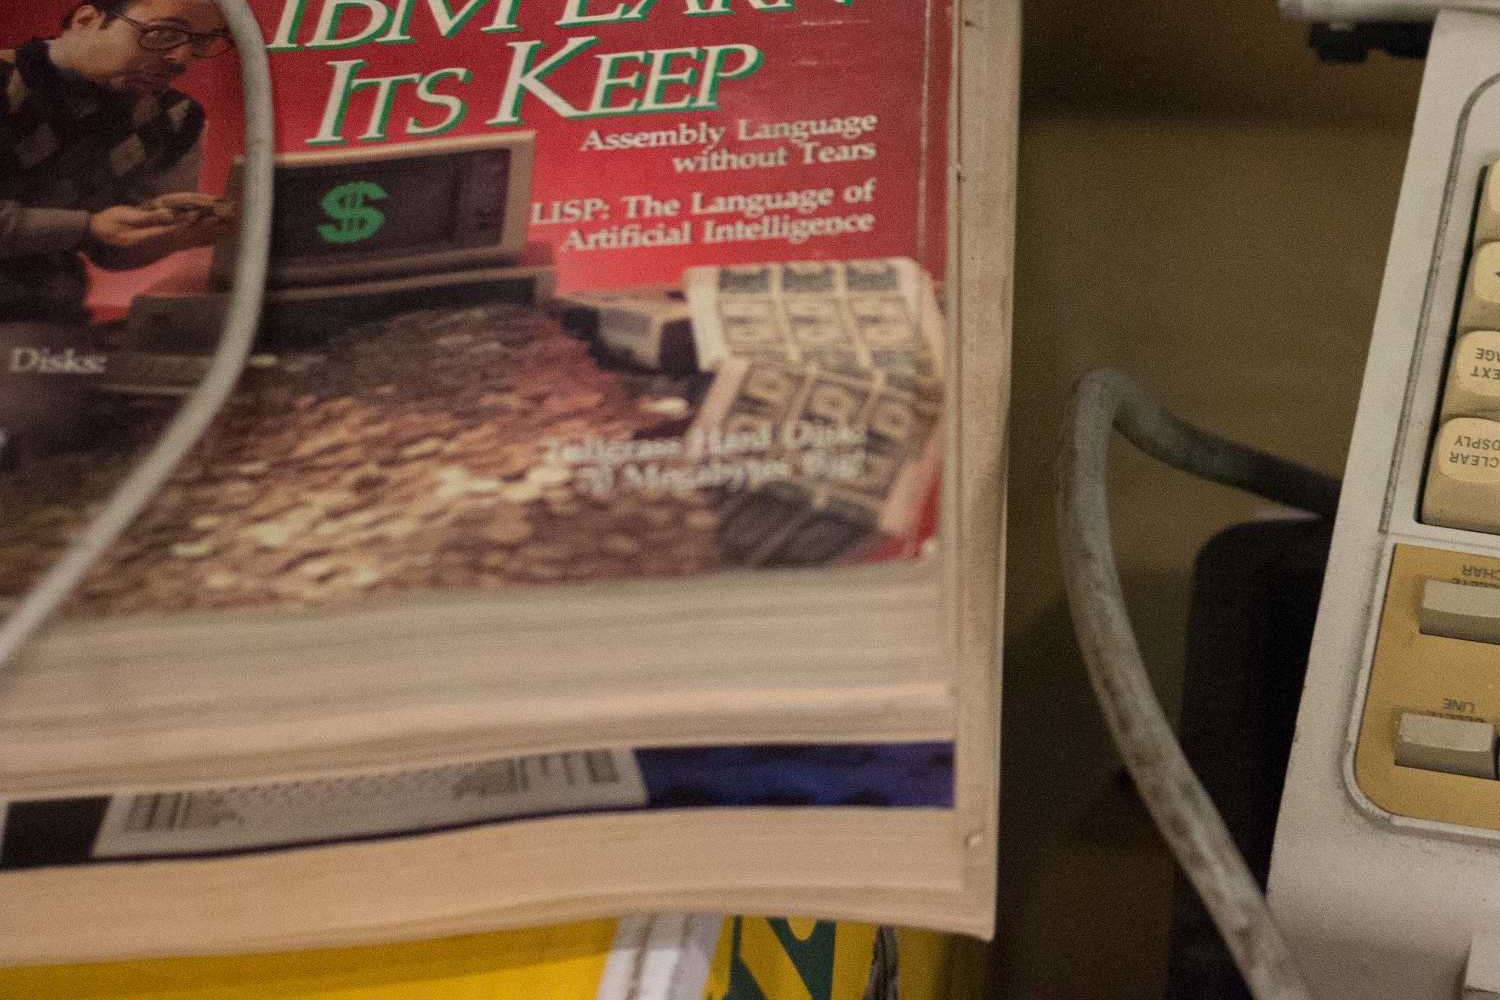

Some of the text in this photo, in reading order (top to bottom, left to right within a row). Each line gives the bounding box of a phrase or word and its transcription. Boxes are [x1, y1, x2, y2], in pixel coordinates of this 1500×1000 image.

[305, 35, 765, 147] ITS KEEP
[580, 114, 878, 151] Assembly Language
[672, 142, 876, 173] without Tears
[530, 177, 877, 225] LISP: The Language of
[560, 213, 876, 252] Artificial Intelligence
[1449, 451, 1500, 468] CLEAR
[1442, 698, 1475, 713] LINE
